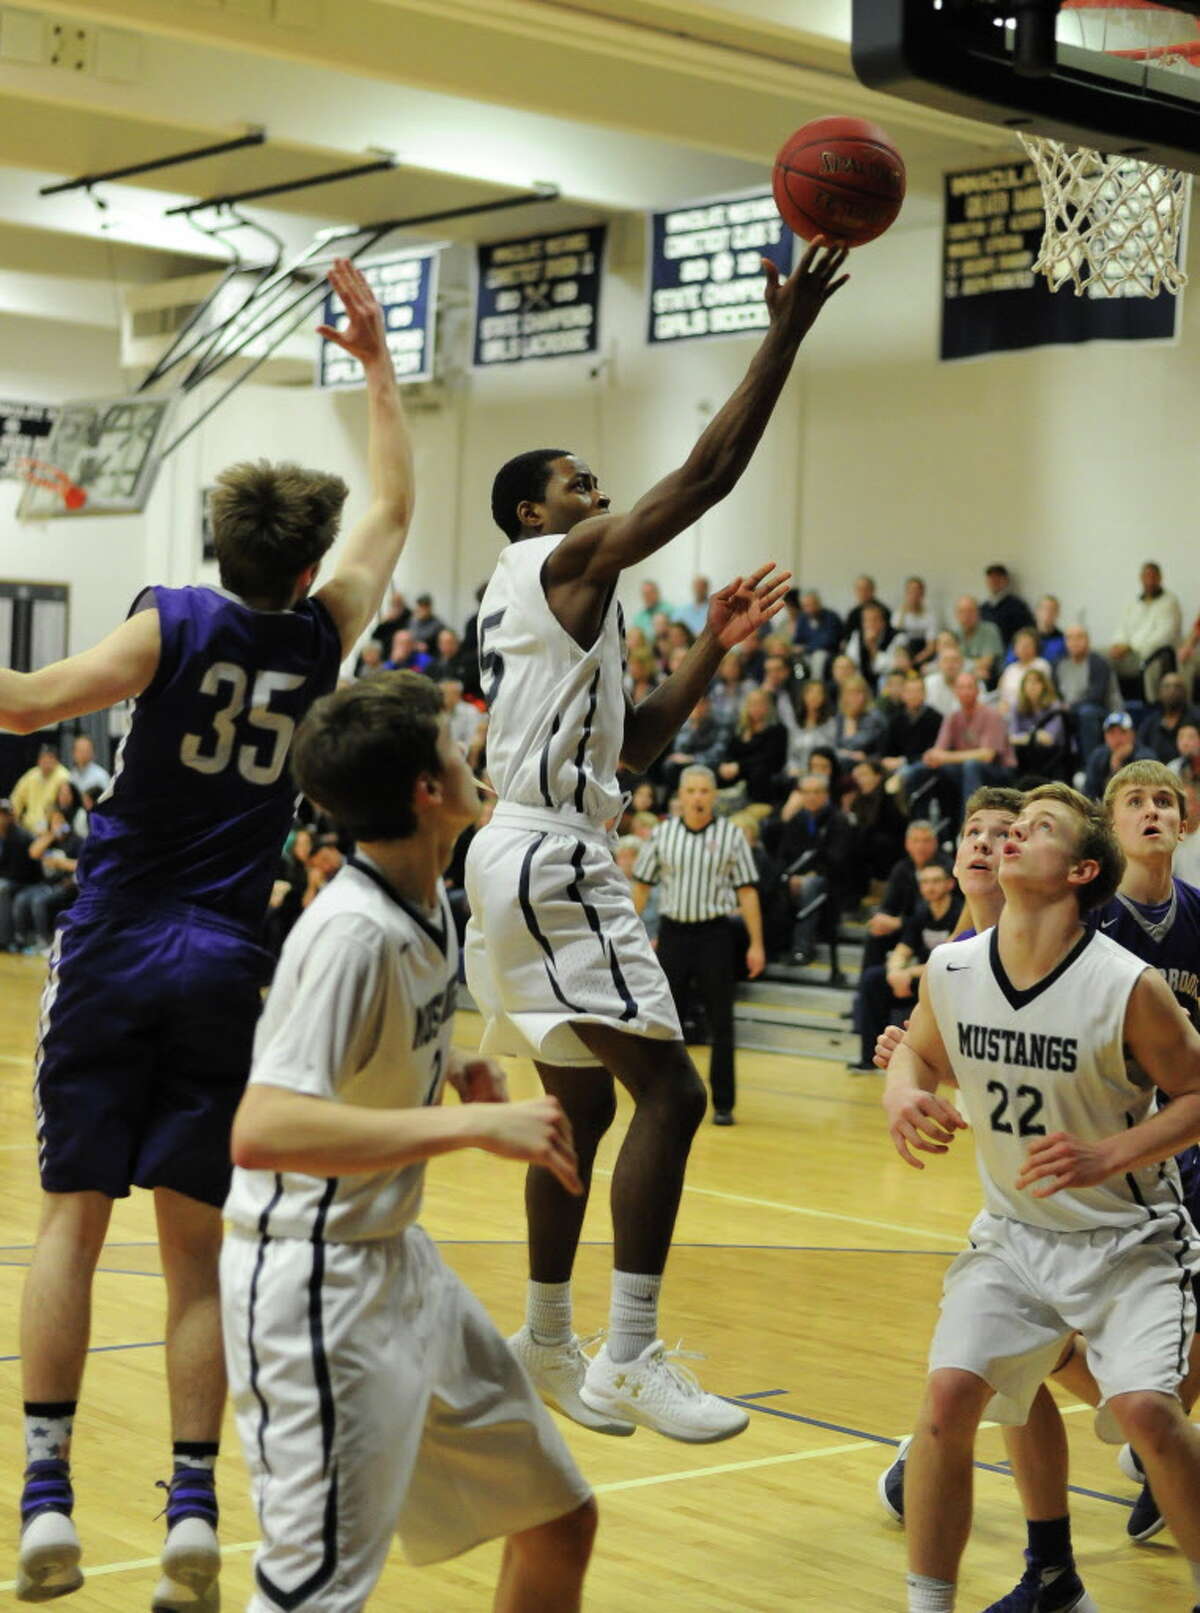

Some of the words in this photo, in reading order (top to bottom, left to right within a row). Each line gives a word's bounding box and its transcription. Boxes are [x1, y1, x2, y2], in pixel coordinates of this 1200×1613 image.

[180, 661, 306, 785] 35
[957, 1022, 1078, 1073] MUSTANGS
[987, 1080, 1046, 1137] 22
